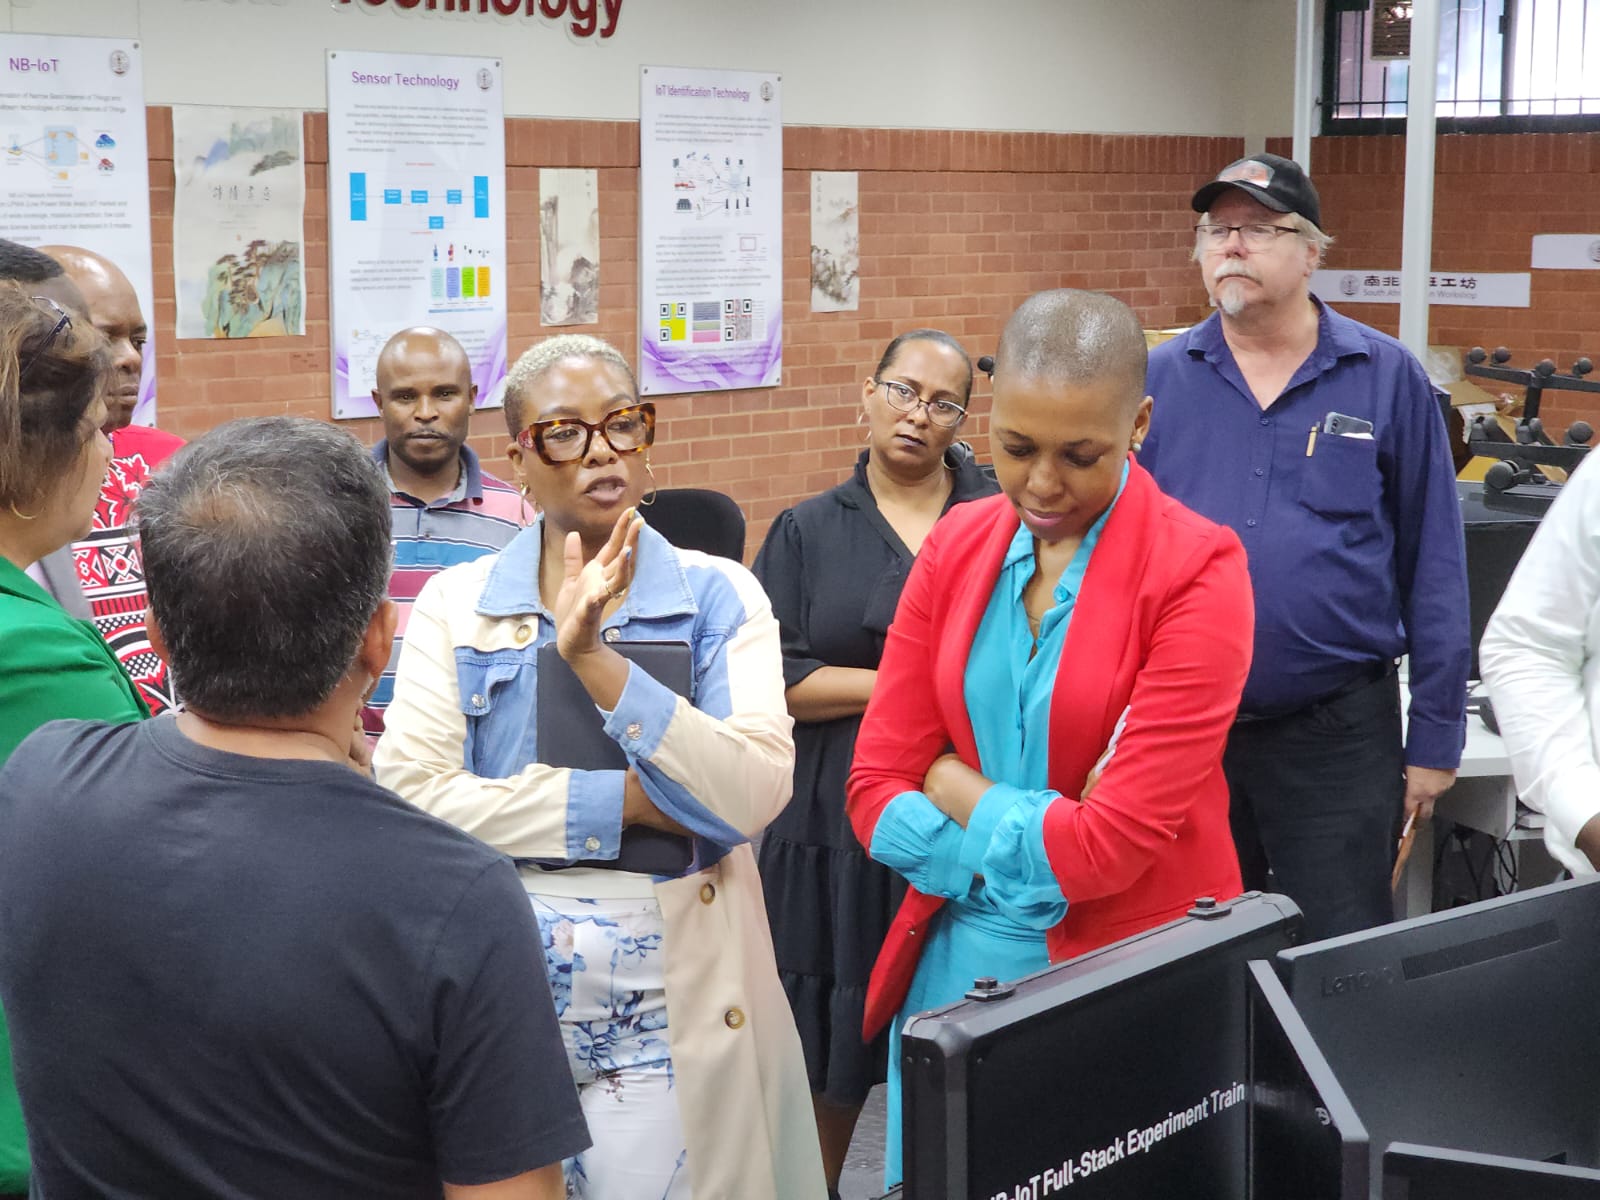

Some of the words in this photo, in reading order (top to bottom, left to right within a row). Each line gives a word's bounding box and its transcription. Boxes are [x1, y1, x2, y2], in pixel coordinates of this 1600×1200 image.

[9, 58, 60, 73] NB-IoT
[351, 71, 392, 85] Sensor
[394, 73, 460, 90] Technology
[655, 84, 667, 96] IoT
[668, 84, 711, 98] Identification
[711, 87, 751, 102] Technology
[1364, 275, 1477, 290] 南非工坊
[1363, 288, 1386, 297] South
[1437, 290, 1478, 299] Workshop
[1043, 1137, 1125, 1196] Full-Stack
[1127, 1099, 1209, 1155] Experiment
